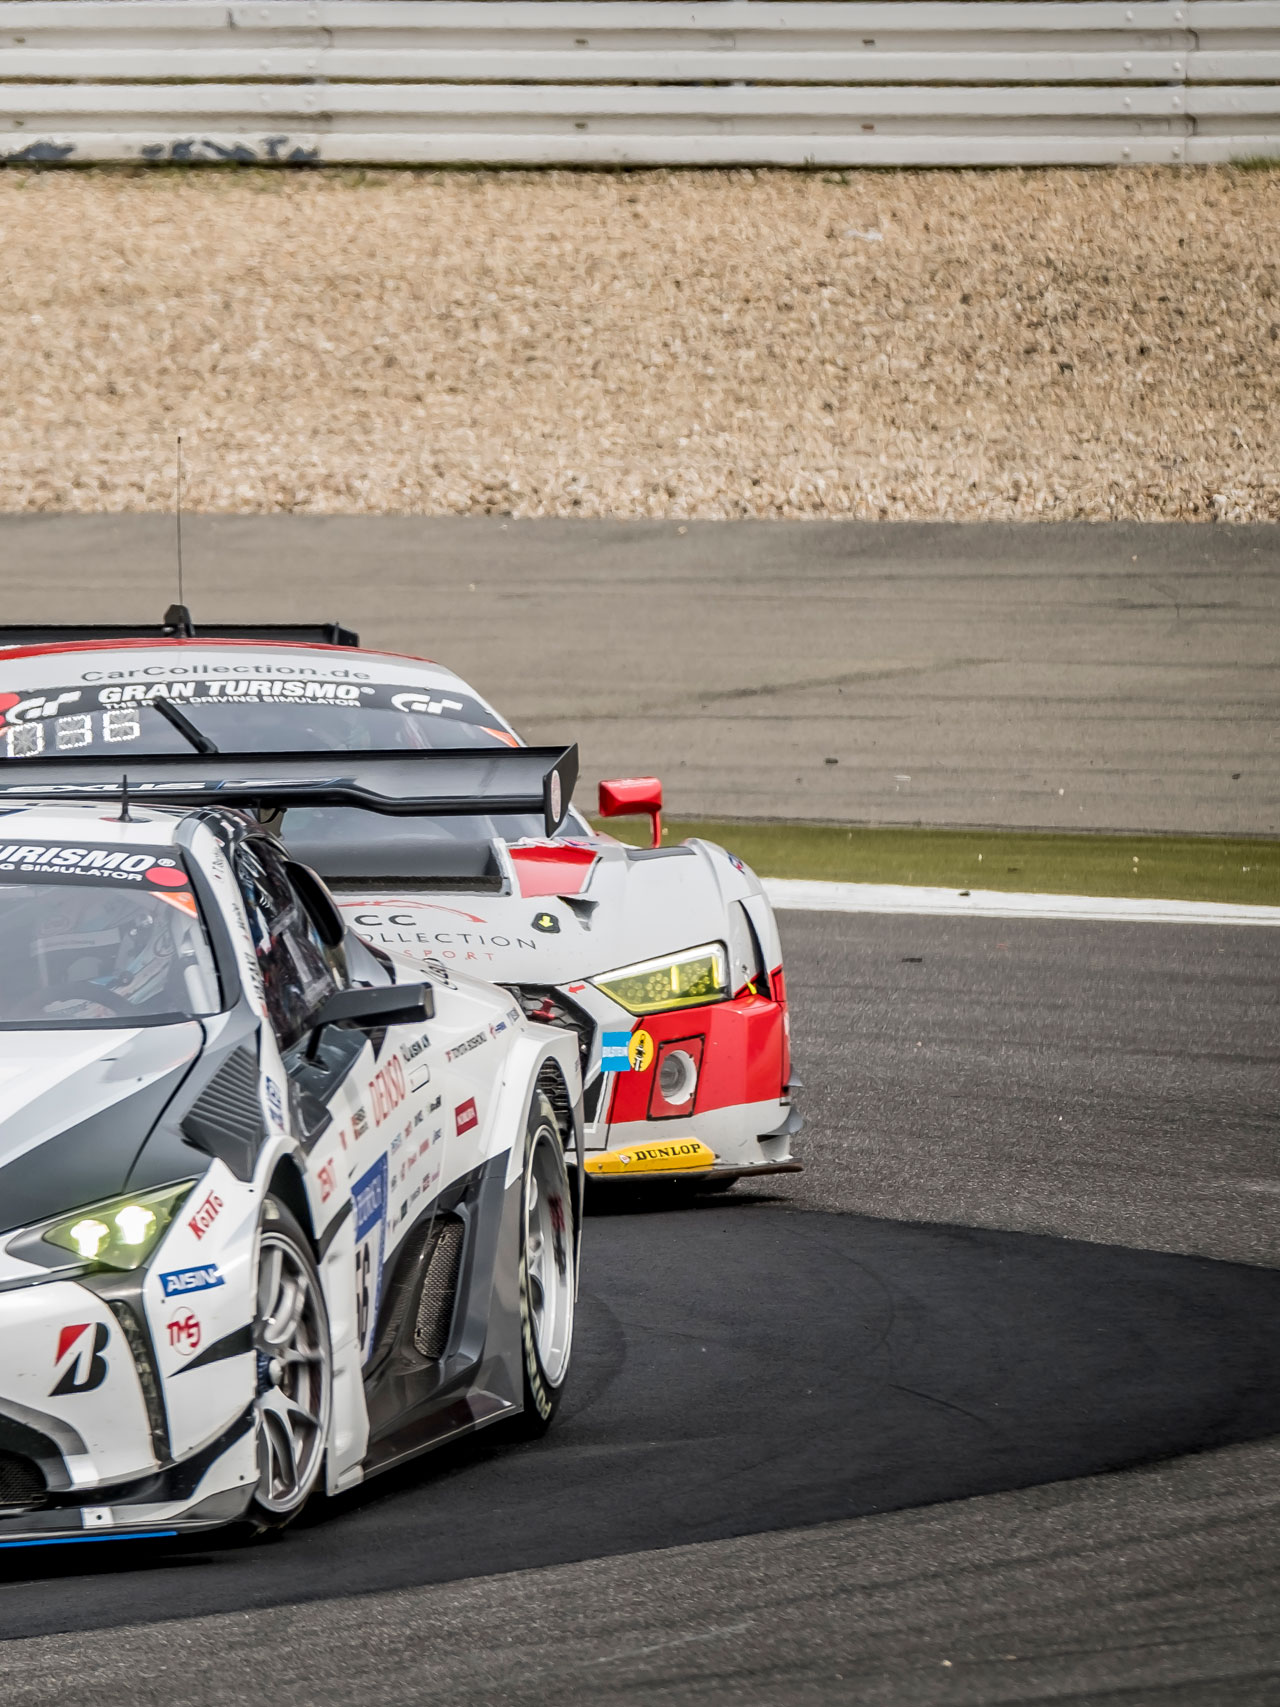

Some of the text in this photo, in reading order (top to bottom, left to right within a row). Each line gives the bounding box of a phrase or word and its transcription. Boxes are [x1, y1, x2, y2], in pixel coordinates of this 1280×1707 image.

[81, 664, 371, 682] CarCollection.de
[98, 682, 196, 704] GRAN
[102, 700, 138, 710] THE
[189, 694, 261, 705] DRIVING
[262, 696, 362, 708] SIMULATOR
[19, 863, 144, 883] SIMULATOR
[354, 914, 418, 927] CC
[360, 933, 537, 950] OLLECTION
[634, 1143, 701, 1161] DUNLOP
[166, 1267, 216, 1293] AISIN
